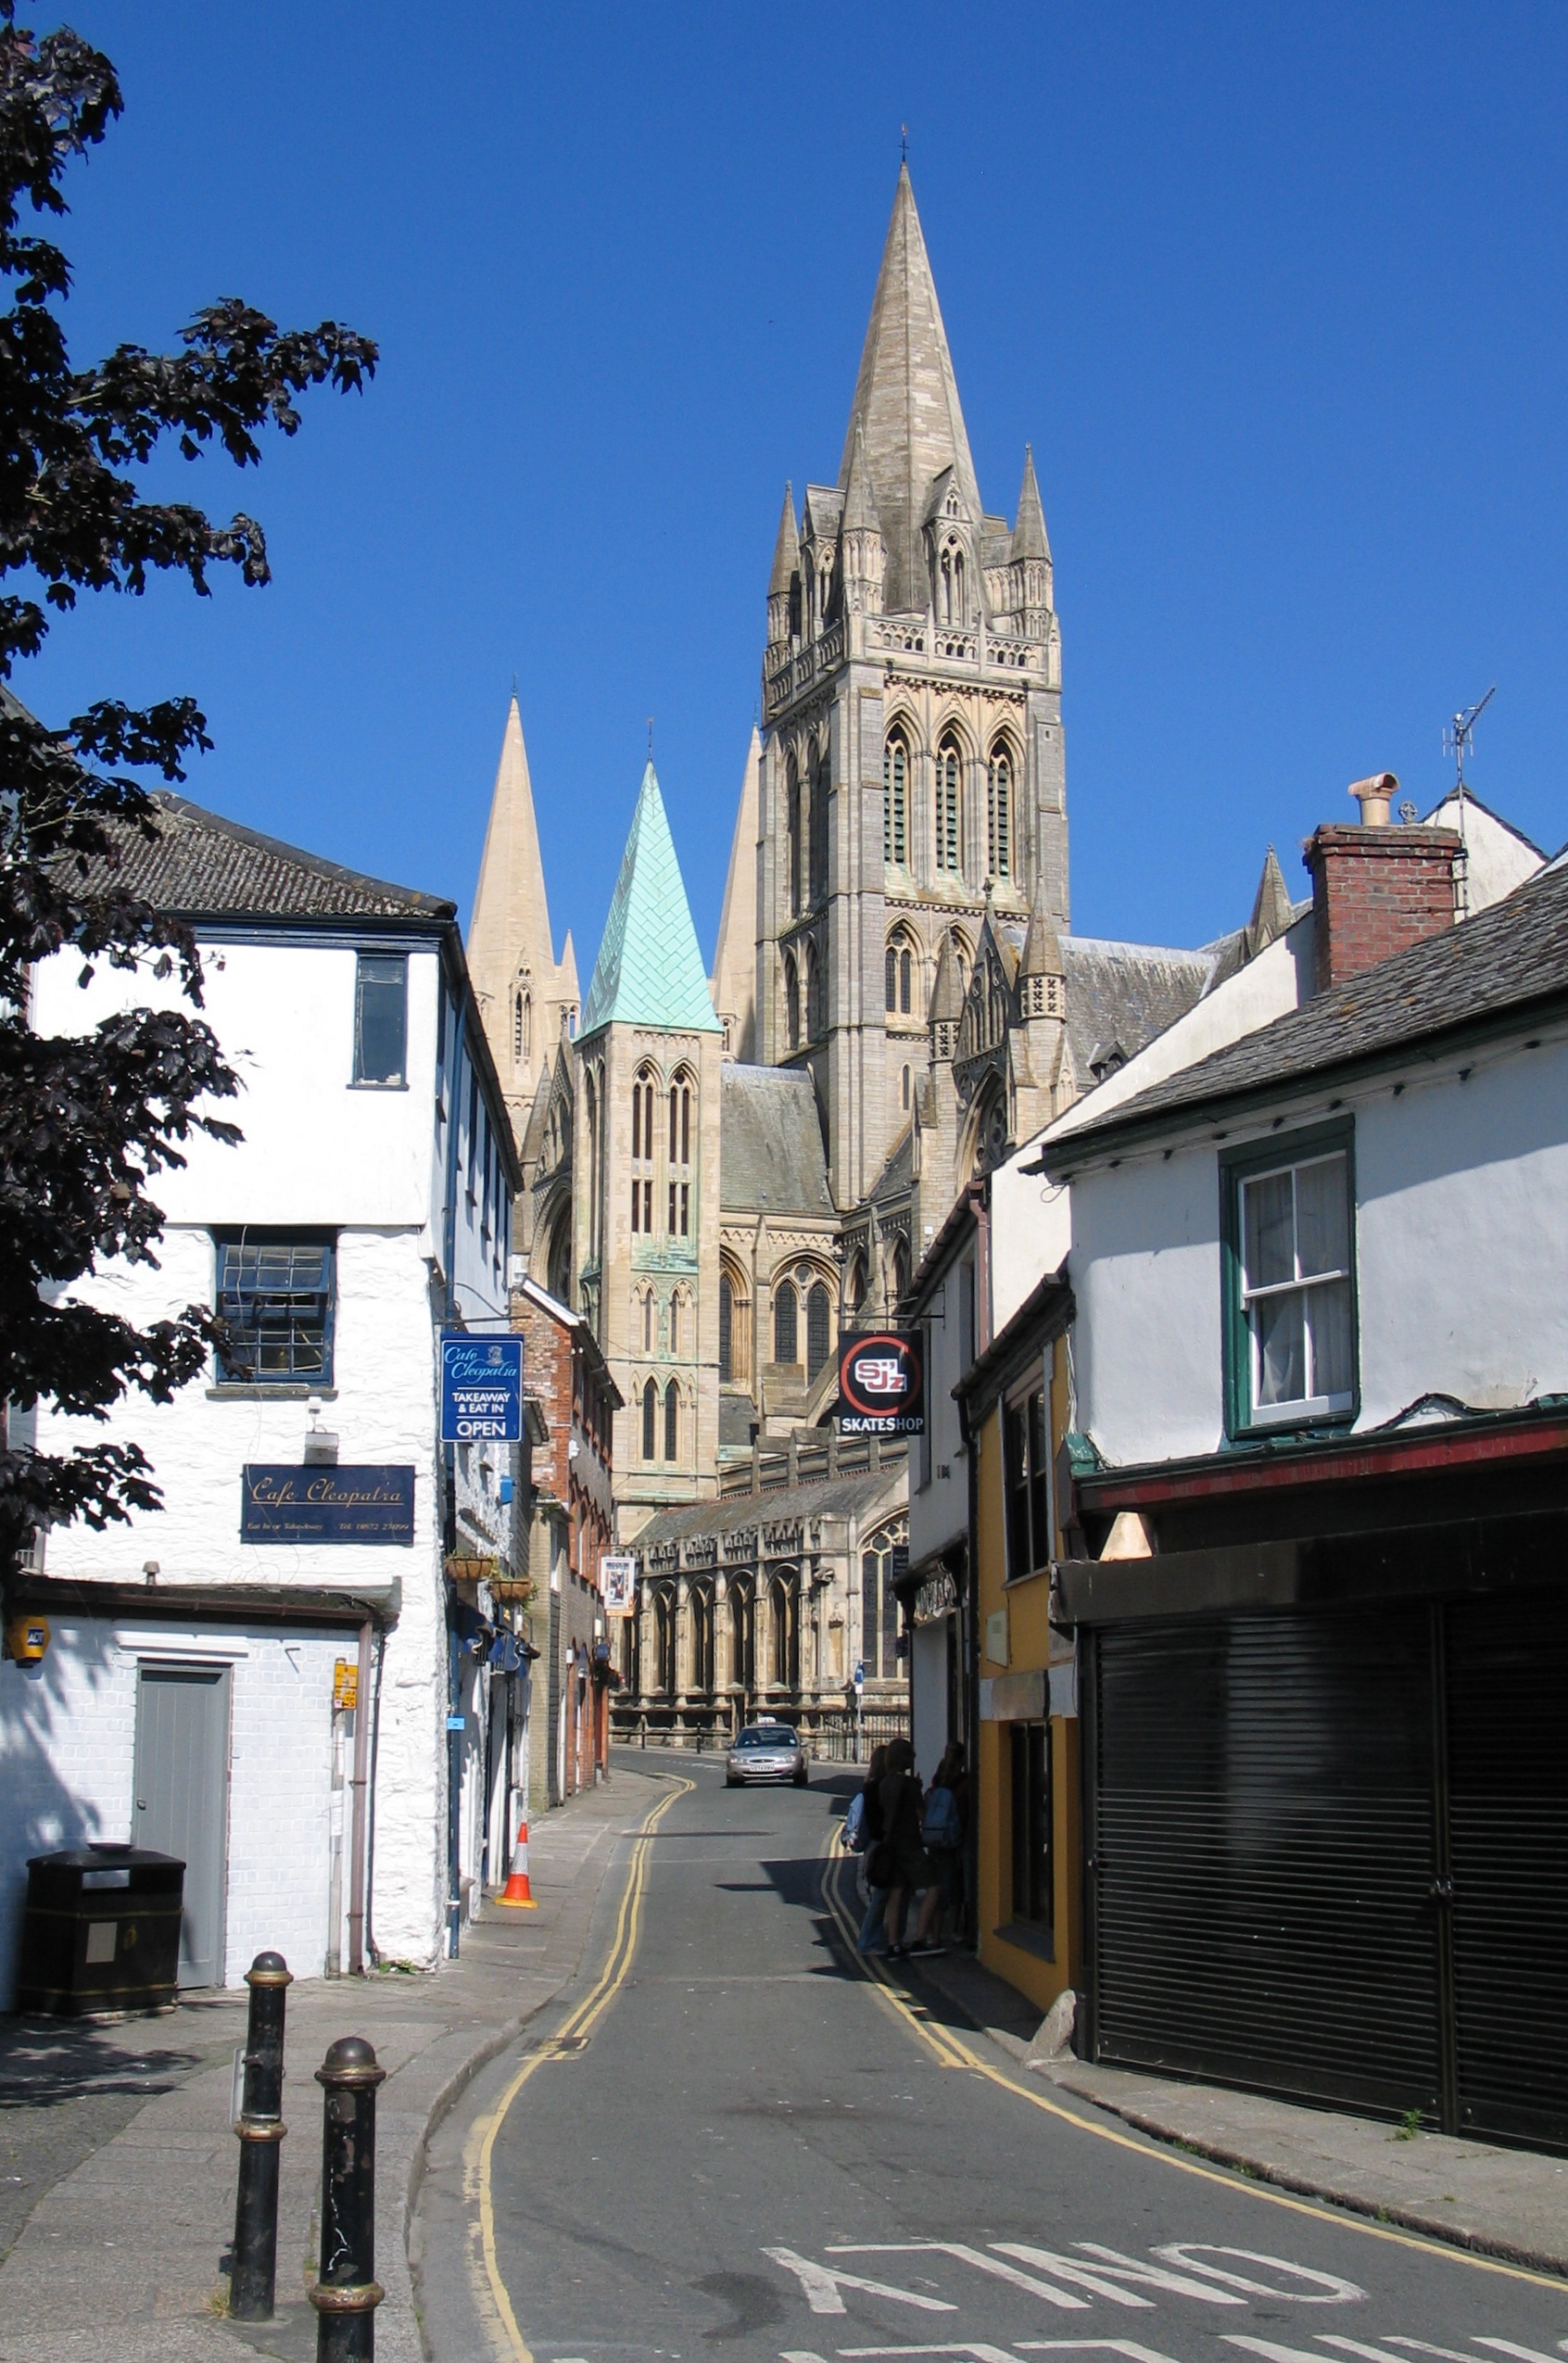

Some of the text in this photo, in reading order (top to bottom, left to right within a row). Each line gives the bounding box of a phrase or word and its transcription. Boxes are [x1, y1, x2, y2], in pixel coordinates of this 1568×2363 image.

[445, 1346, 478, 1363] Cafe
[451, 1358, 517, 1384] Cleopatra
[452, 1392, 511, 1403] TAKEAWAY
[458, 1403, 504, 1413] & EAT IN
[457, 1421, 506, 1436] OPEN
[841, 1417, 924, 1432] SKATESHOP
[252, 1476, 403, 1509] Cafe Cleopatra
[759, 2241, 1372, 2315] ONLY
